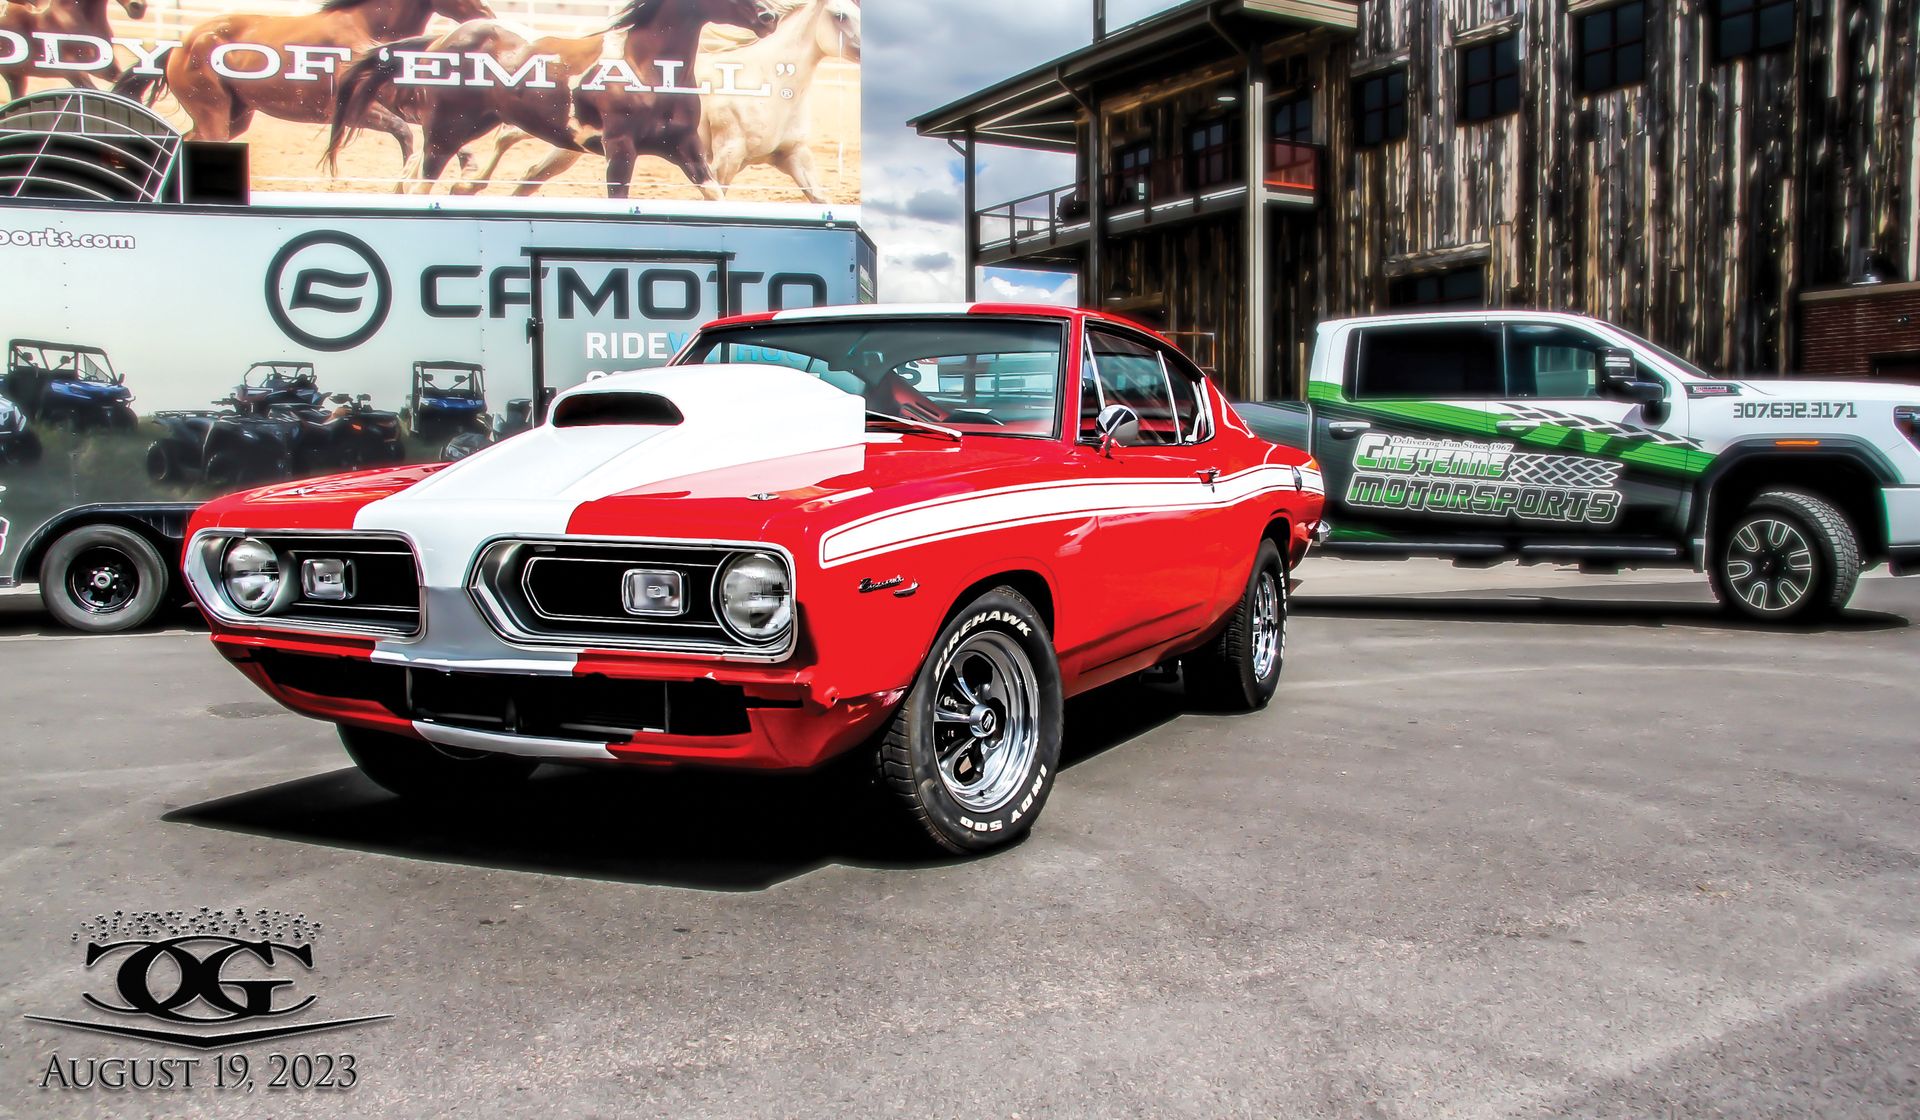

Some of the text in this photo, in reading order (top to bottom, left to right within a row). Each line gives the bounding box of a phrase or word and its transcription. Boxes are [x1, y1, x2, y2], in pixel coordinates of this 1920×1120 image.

[210, 42, 352, 81] OF
[1733, 402, 1858, 419] 307.632.3171
[1393, 436, 1514, 452] Delivering Fun Since 1967
[1346, 472, 1623, 524] MOTORSPORTS
[934, 610, 1032, 682] FIREHAWK
[1011, 763, 1048, 823] INDY
[959, 816, 1003, 832] 500
